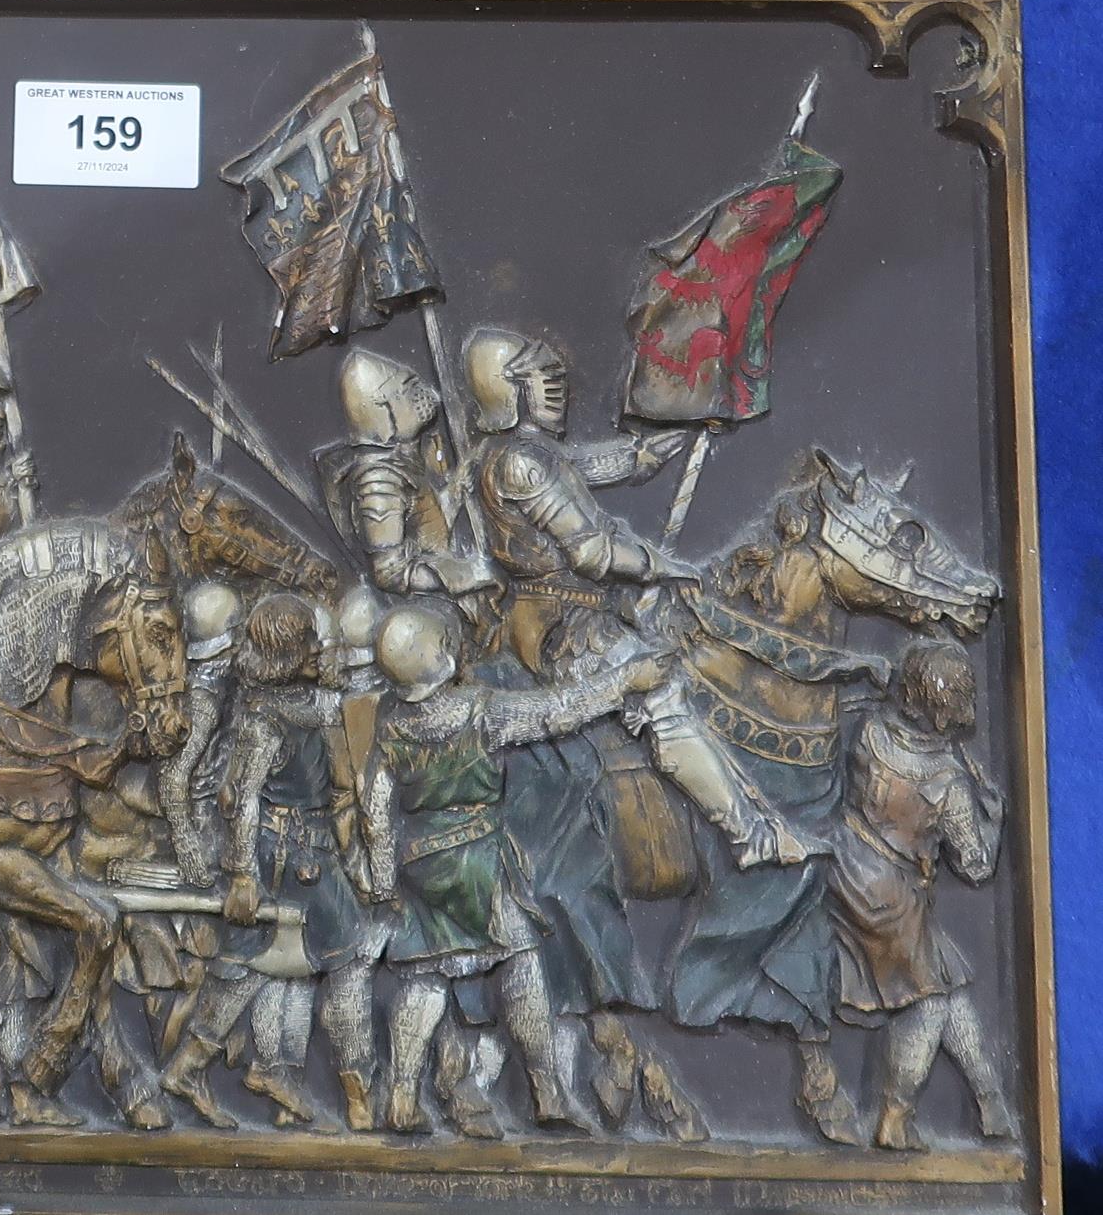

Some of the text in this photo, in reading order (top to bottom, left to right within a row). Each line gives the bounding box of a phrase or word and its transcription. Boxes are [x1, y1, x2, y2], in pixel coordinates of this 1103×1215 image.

[27, 88, 184, 101] GREAT WESTERN AUCTIONS
[67, 114, 143, 152] 159
[77, 162, 128, 172] 27/11/2024
